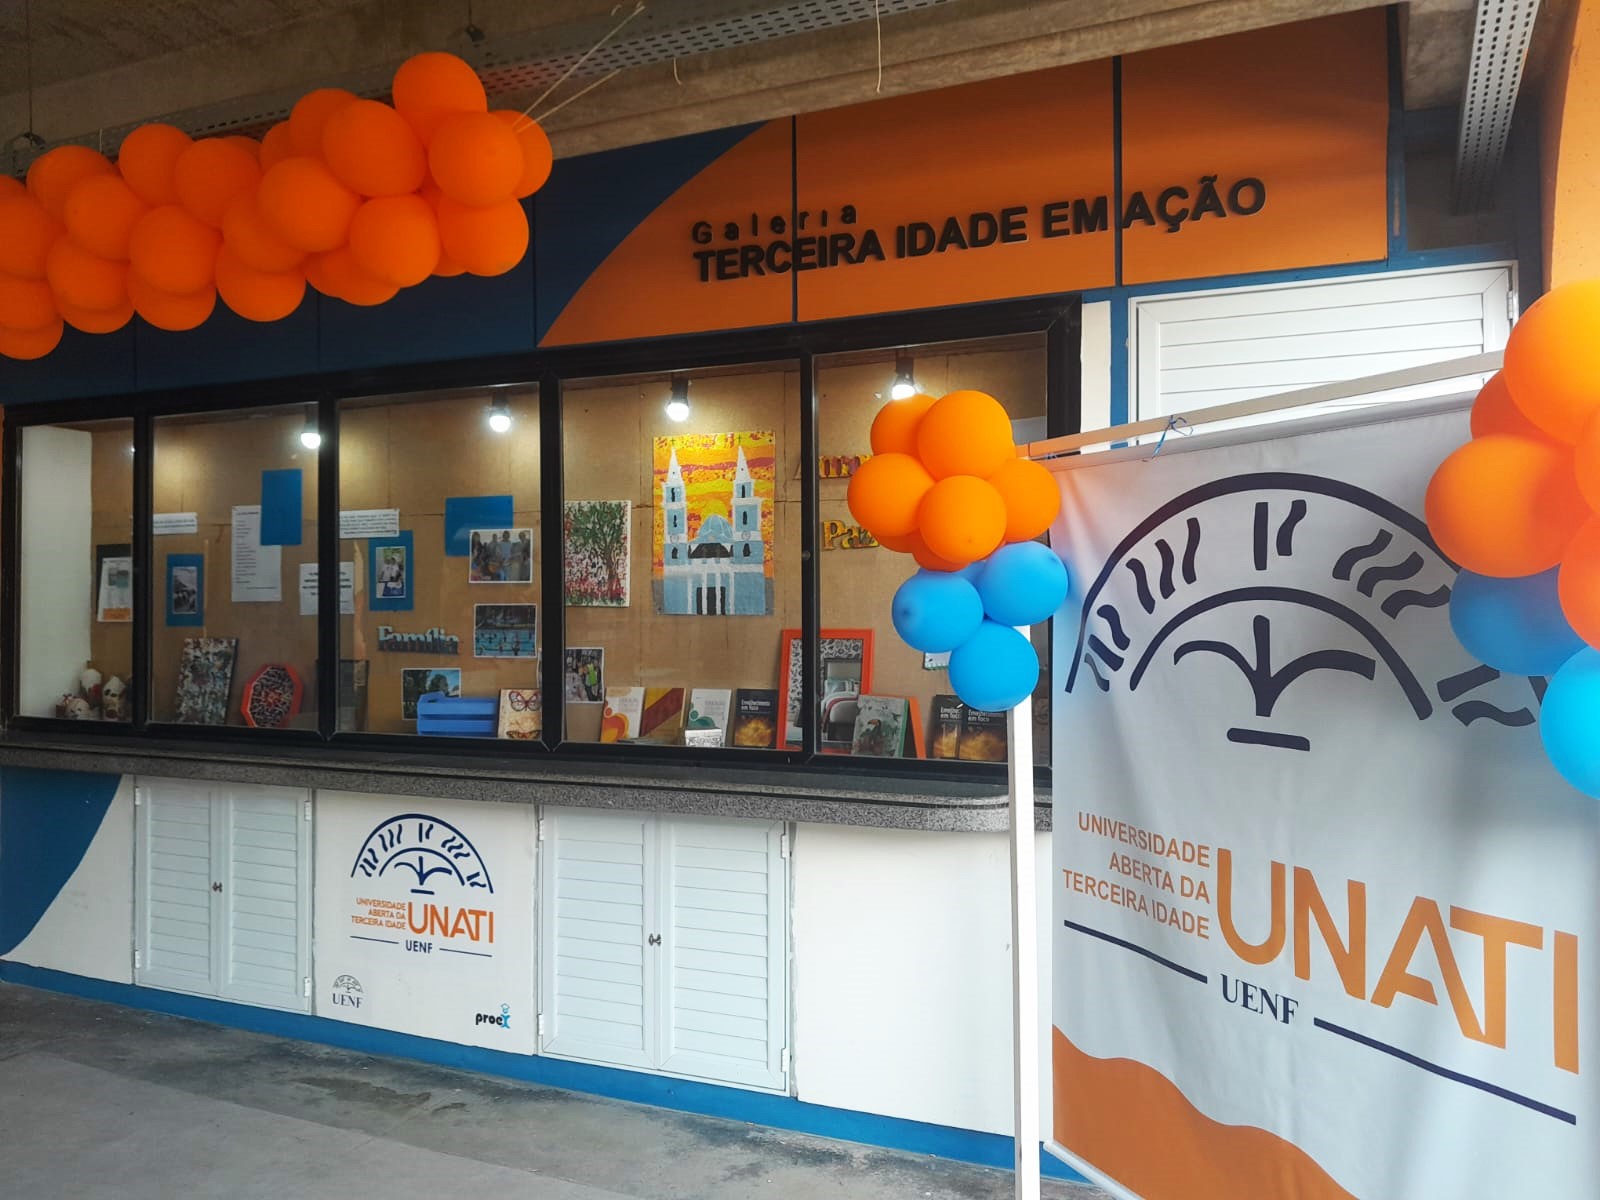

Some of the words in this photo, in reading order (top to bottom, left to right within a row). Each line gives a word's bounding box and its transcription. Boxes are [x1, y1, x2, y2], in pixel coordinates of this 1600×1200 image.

[692, 204, 857, 244] Galeria
[693, 229, 885, 282] TERCEIRA
[896, 205, 1028, 258] IDADE
[1043, 195, 1108, 238] EM
[1121, 174, 1267, 234] AÇÃO
[1078, 811, 1210, 868] UNIVERSIDADE
[1109, 852, 1175, 893] ABERTA
[1180, 875, 1210, 904] DA
[351, 914, 384, 927] TERCEIRA
[385, 919, 406, 930] IDADE
[356, 897, 406, 911] UNIVERSIDADE
[368, 909, 394, 918] ABERTA
[407, 902, 494, 943] UNATI
[1063, 869, 1148, 917] TERCEIRA
[1152, 900, 1209, 939] IDADE
[405, 939, 433, 954] UENF
[1216, 847, 1580, 1075] UNATI
[332, 992, 363, 1009] UENF
[1220, 973, 1299, 1025] UENF
